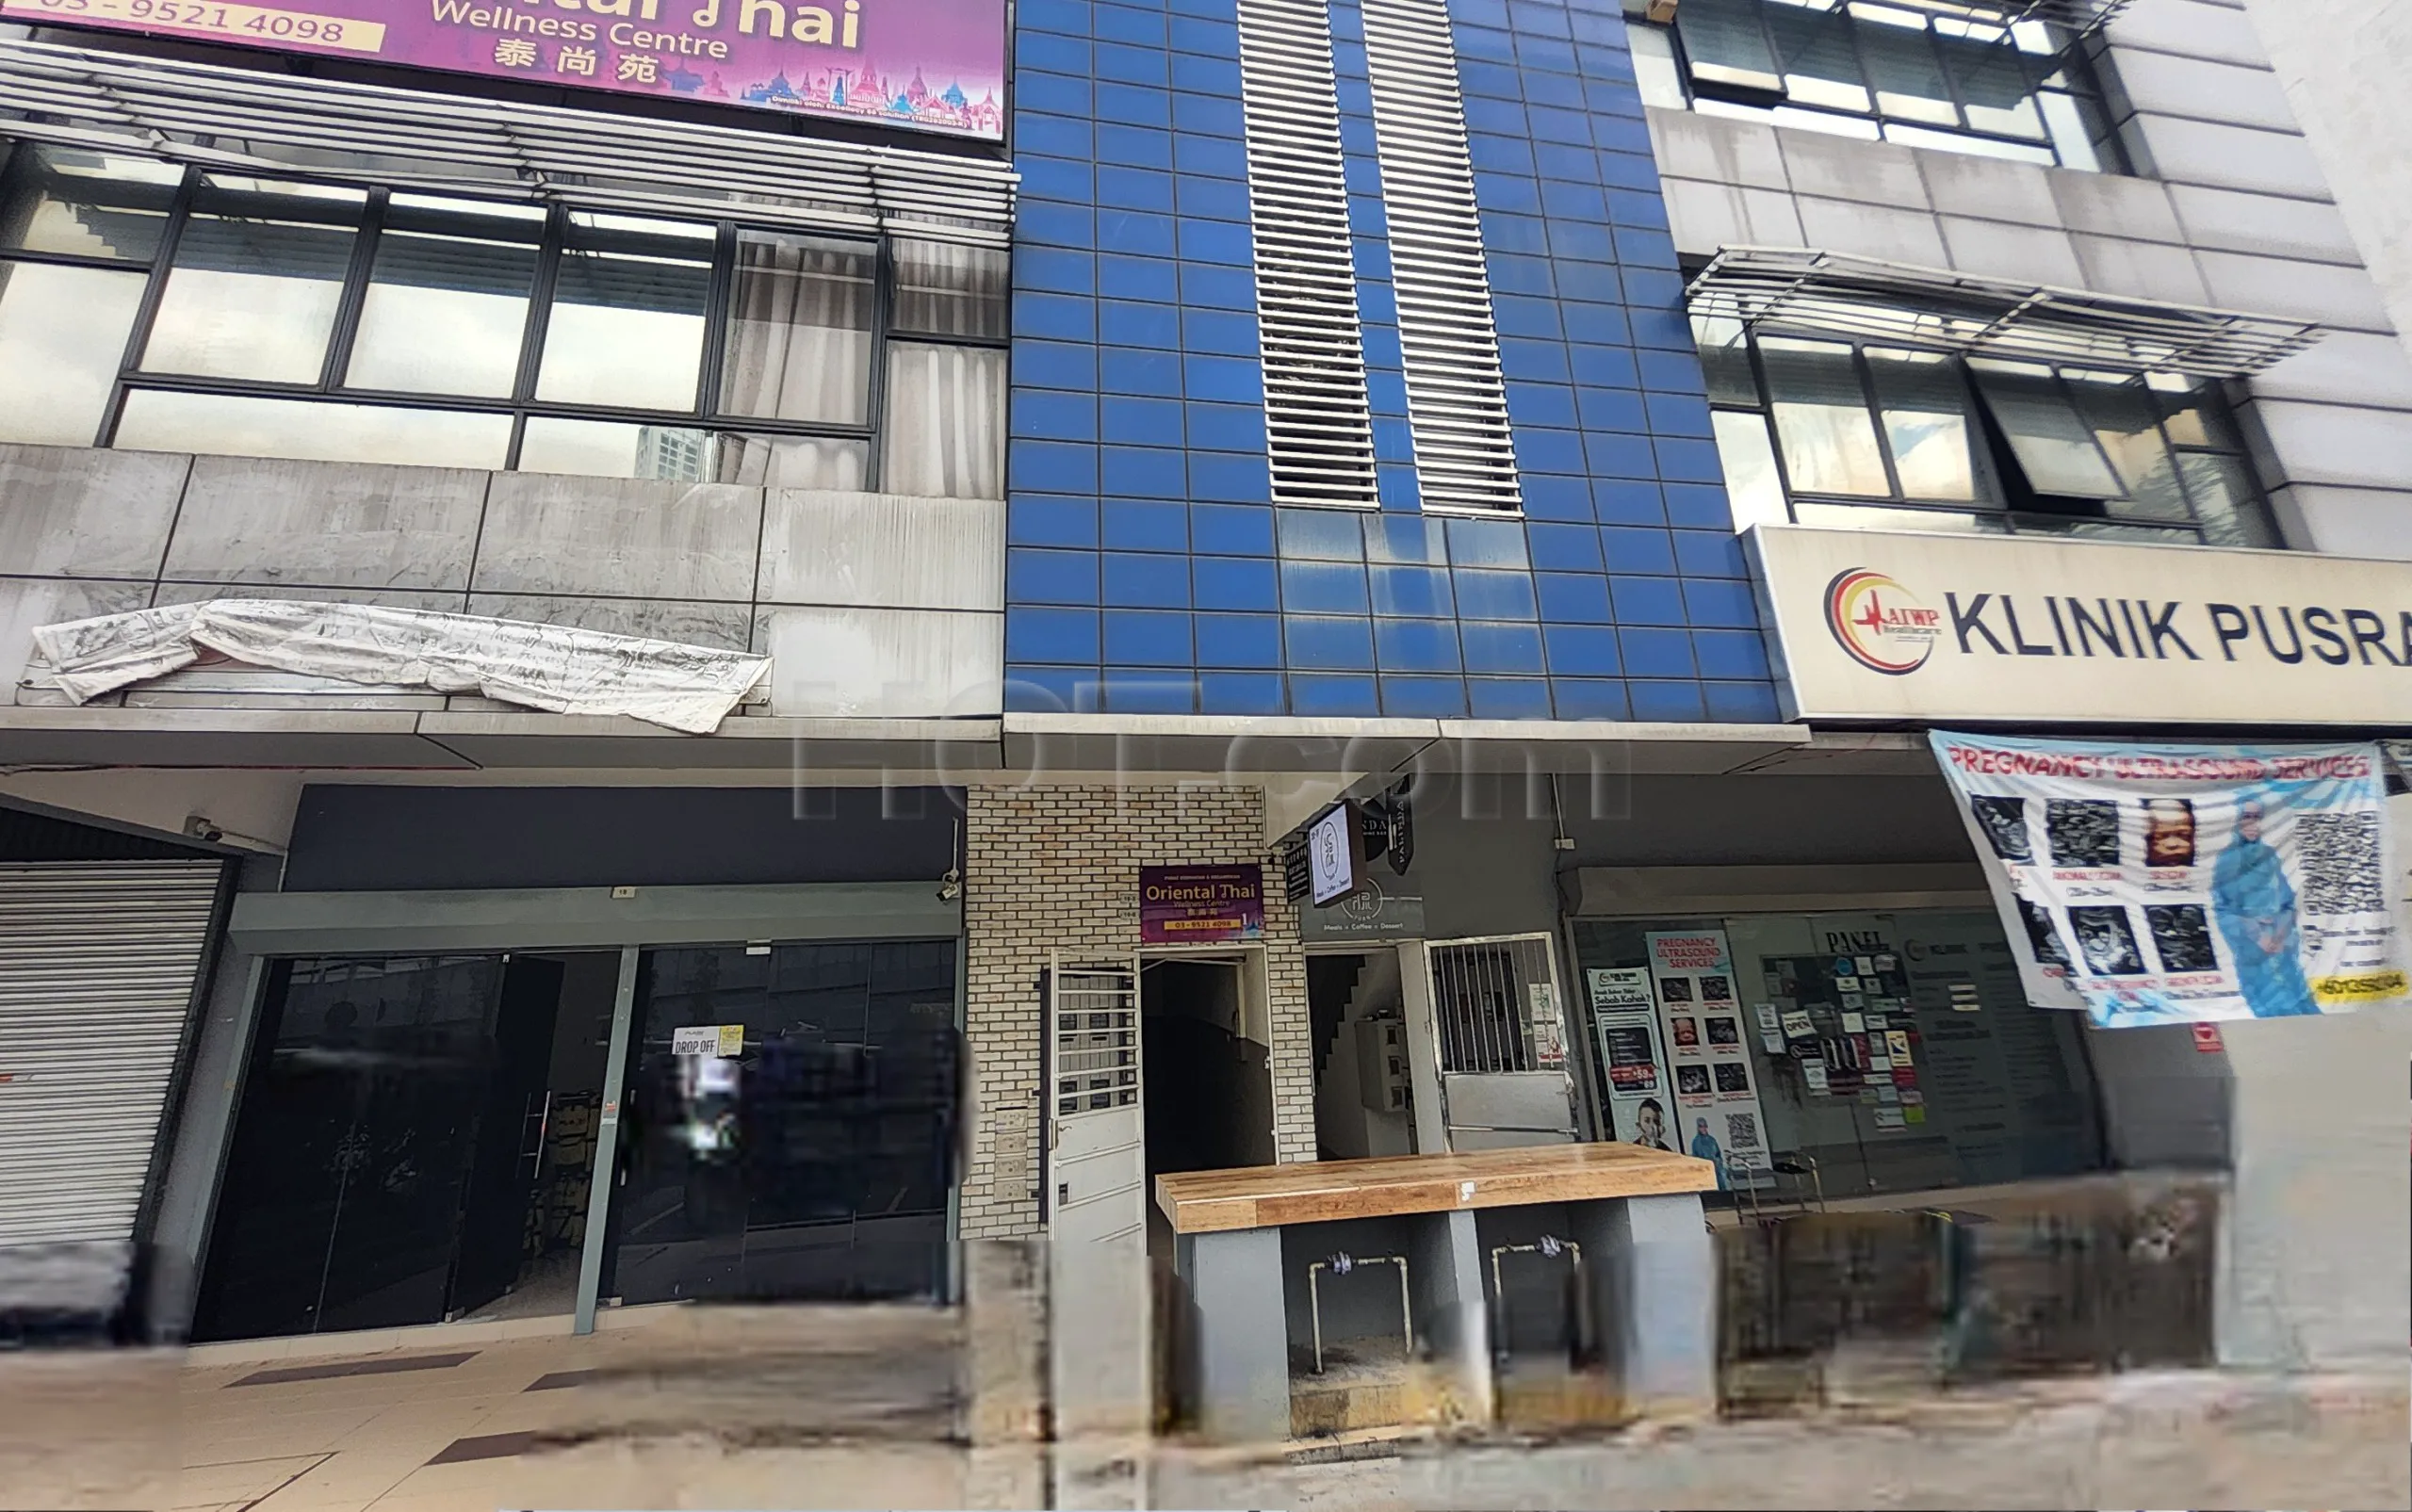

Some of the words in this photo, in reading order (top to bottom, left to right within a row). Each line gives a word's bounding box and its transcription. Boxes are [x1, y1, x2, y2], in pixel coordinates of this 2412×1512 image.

[130, 0, 229, 28] 9521
[243, 14, 345, 42] 4098
[430, 0, 597, 41] Wellness
[610, 23, 728, 59] Centre
[494, 38, 660, 84] 泰尚苑
[1943, 592, 2205, 660] KLINIK
[1146, 885, 1215, 901] Oriental
[1218, 884, 1255, 899] Thai
[1174, 900, 1205, 908] Wellness
[1206, 899, 1230, 907] Centre
[1656, 936, 1716, 948] PREGNANCY
[1656, 947, 1720, 958] ULTRASOUND
[1669, 957, 1715, 968] SERVICES
[1594, 995, 1620, 1004] Sebab
[1785, 1020, 1811, 1032] OPEN
[675, 1040, 699, 1054] DROP
[700, 1039, 716, 1053] OFF
